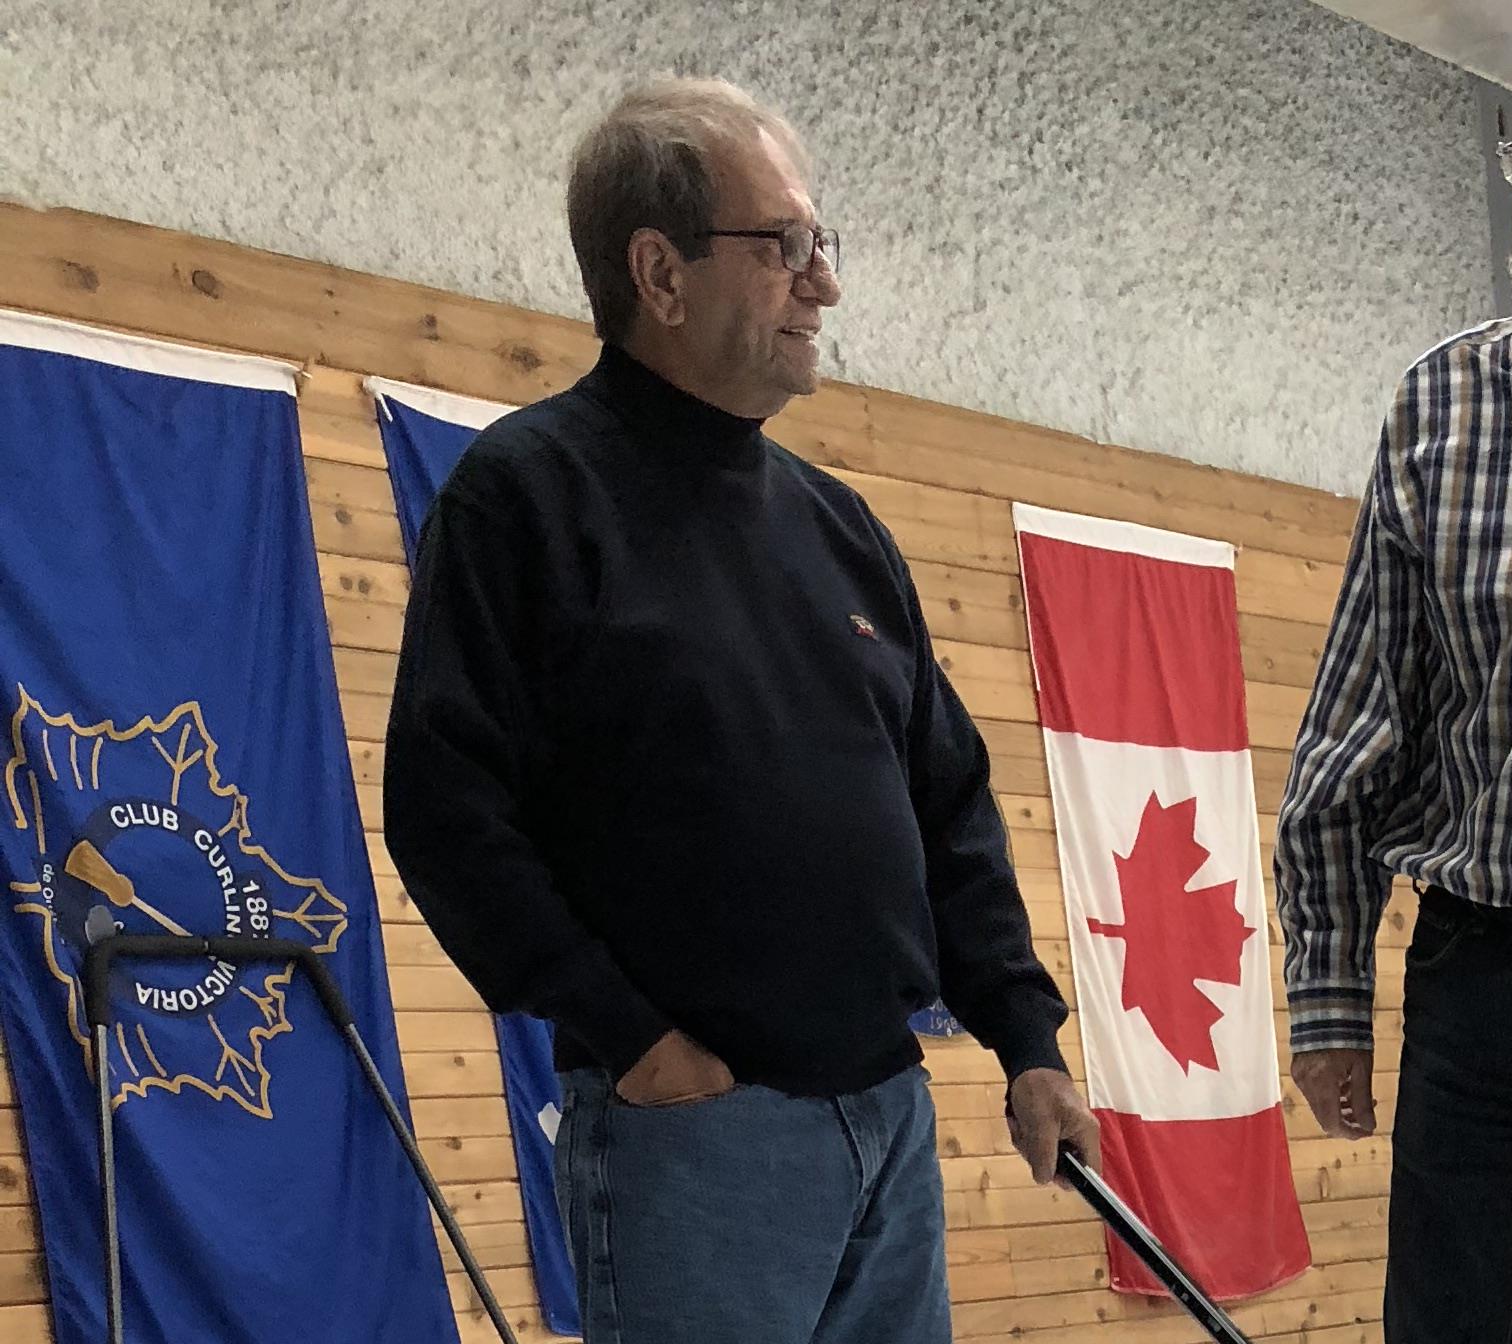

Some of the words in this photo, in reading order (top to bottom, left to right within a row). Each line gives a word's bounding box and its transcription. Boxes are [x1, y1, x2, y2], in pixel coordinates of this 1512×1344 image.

[110, 803, 179, 832] CLUB
[194, 829, 242, 938] CURLIN
[242, 880, 269, 939] 188
[136, 960, 237, 1012] VICTORIA
